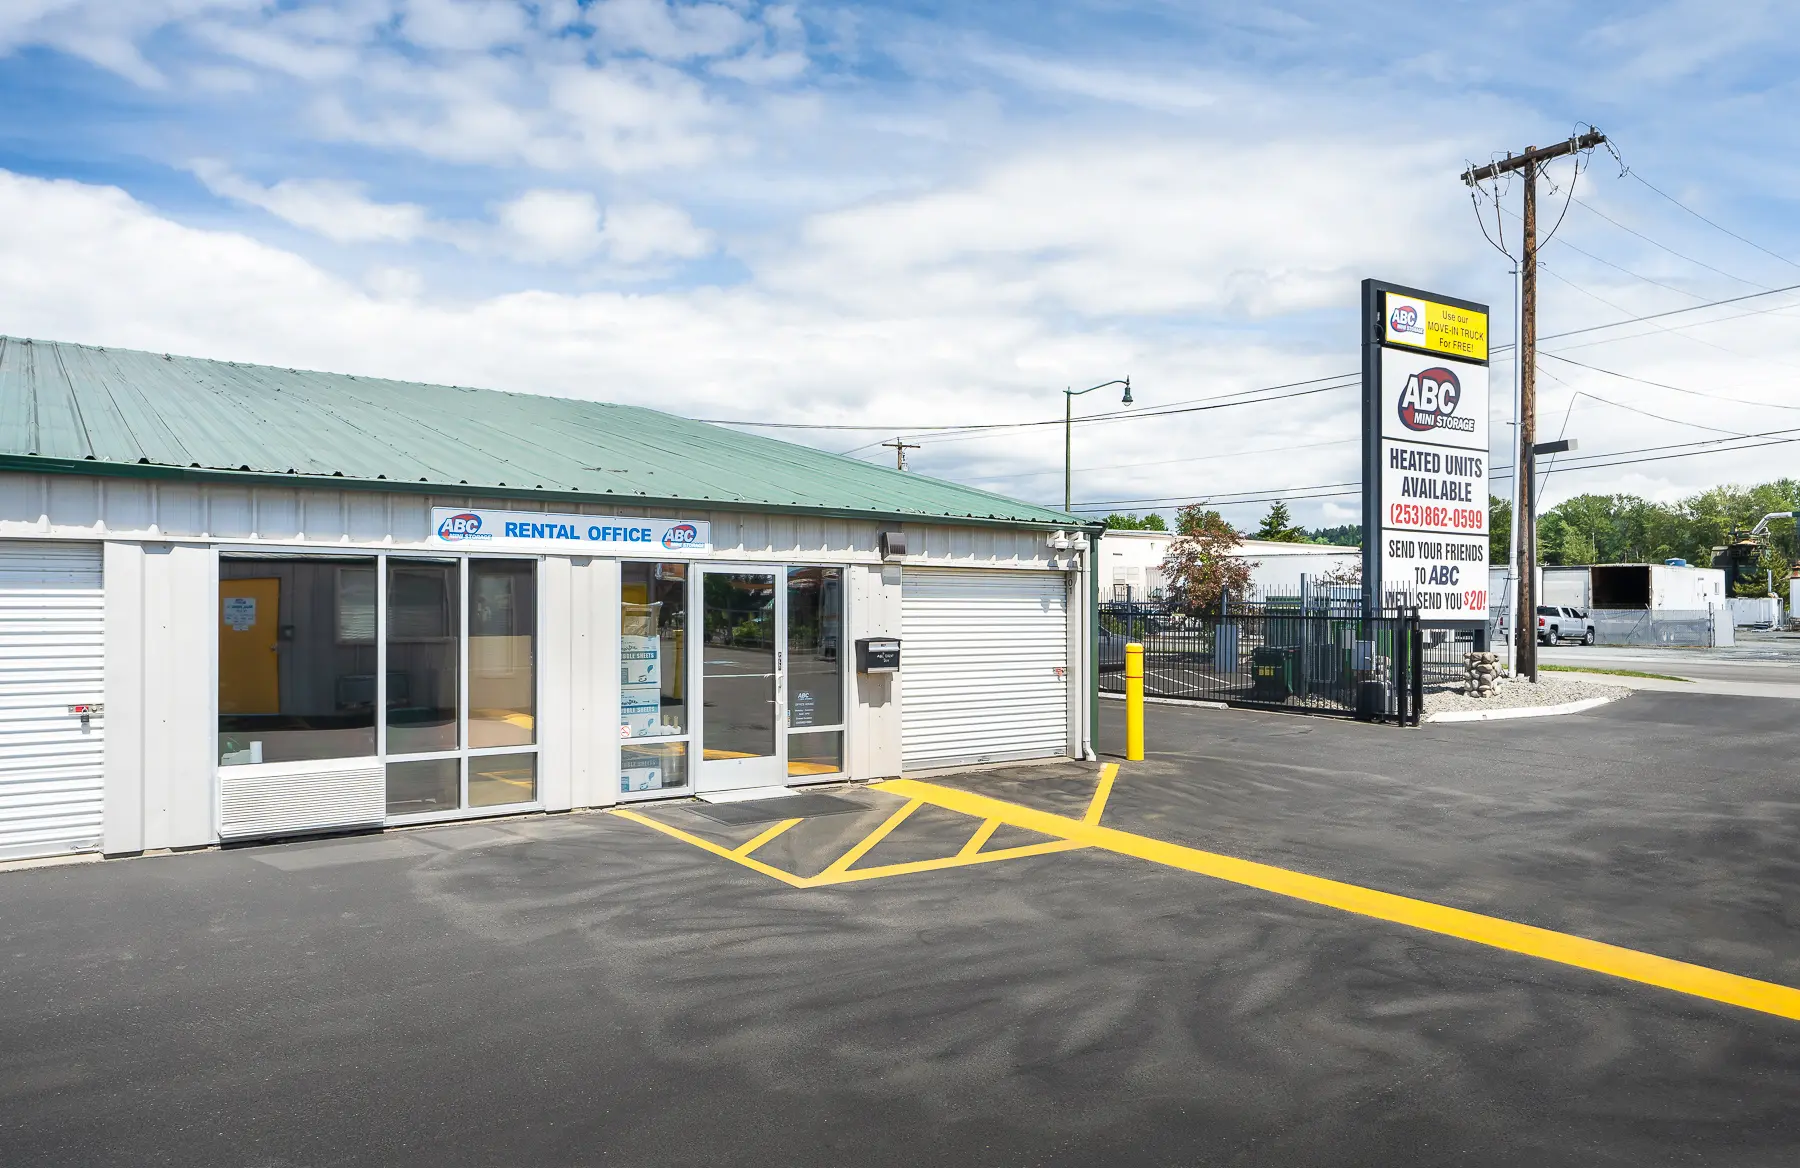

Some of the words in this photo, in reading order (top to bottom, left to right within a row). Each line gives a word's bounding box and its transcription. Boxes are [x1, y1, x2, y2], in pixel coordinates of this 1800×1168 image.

[1392, 309, 1416, 326] ABC
[1442, 310, 1456, 321] Use
[1427, 321, 1459, 336] MOVE-IN
[1461, 328, 1484, 341] TRUCK
[1439, 338, 1451, 348] For
[1453, 340, 1474, 353] FREE!
[1401, 375, 1456, 415] ABC
[1413, 412, 1435, 426] MINI
[1436, 414, 1475, 432] STORAGE
[1390, 448, 1440, 473] HEATED
[1445, 454, 1483, 478] UNITS
[1401, 476, 1472, 502] AVAILABLE
[441, 518, 479, 534] ABC
[1390, 503, 1482, 529] (253)862-0599
[505, 521, 581, 540] RENTAL
[587, 526, 652, 542] OFFICE
[664, 529, 695, 543] ABC
[1389, 539, 1415, 558] SEND
[1418, 541, 1442, 560] YOUR
[1445, 543, 1483, 562] FRIENDS
[1414, 566, 1426, 585] TO
[1428, 565, 1459, 586] ABC
[1416, 591, 1442, 610] SEND
[1444, 592, 1462, 610] YOU
[1463, 590, 1487, 611] $20!
